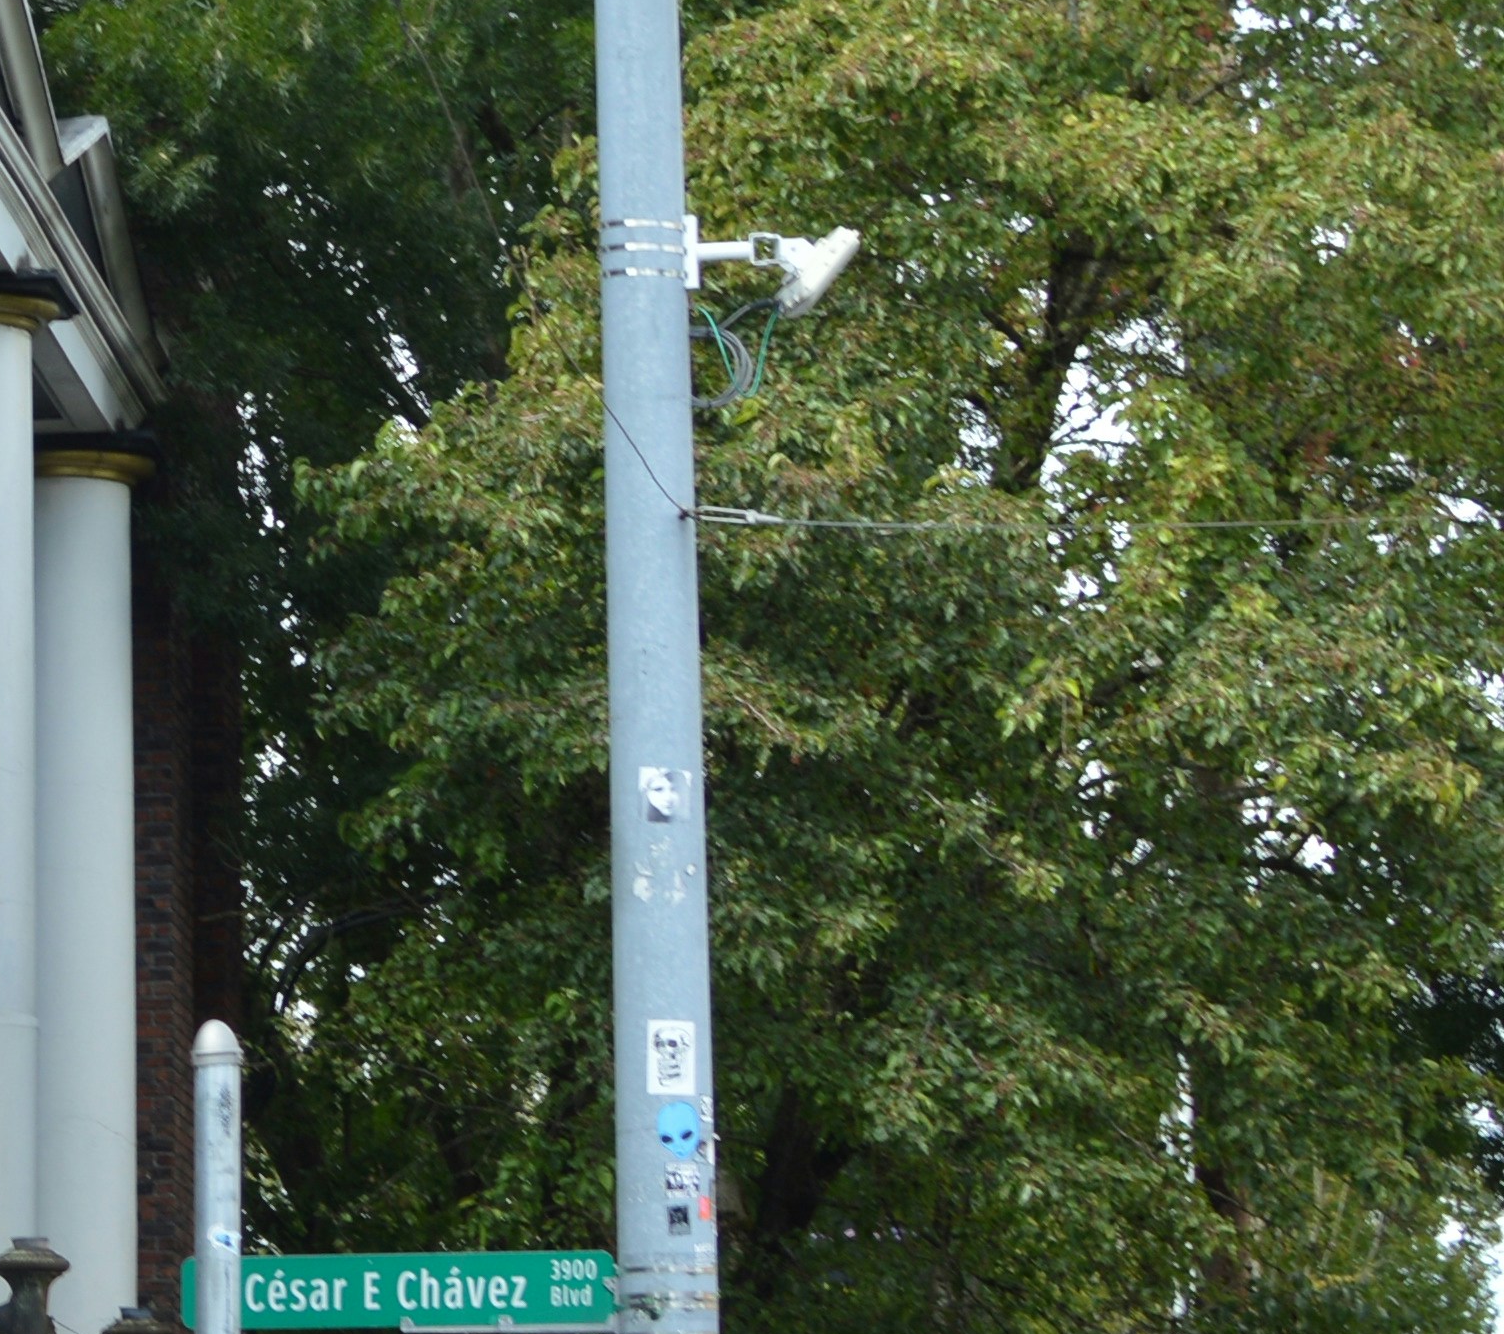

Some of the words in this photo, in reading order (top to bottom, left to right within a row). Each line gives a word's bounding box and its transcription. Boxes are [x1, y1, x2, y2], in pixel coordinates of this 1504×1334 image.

[549, 1258, 598, 1280] 3900
[245, 1267, 348, 1312] César
[364, 1271, 382, 1311] E
[396, 1266, 528, 1311] Chávez
[550, 1284, 594, 1307] Blvd
